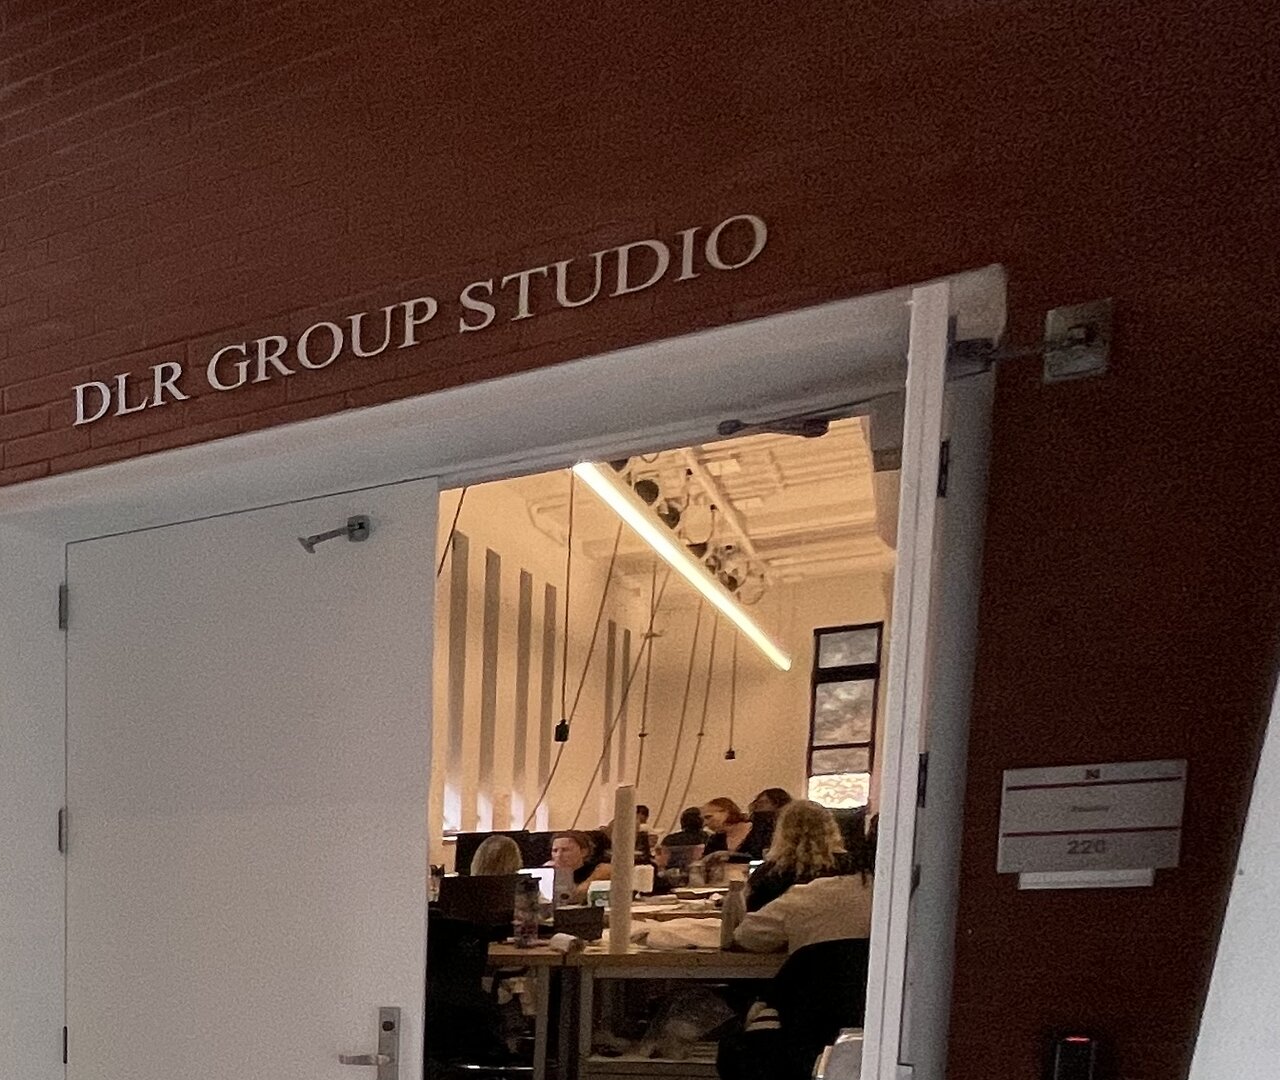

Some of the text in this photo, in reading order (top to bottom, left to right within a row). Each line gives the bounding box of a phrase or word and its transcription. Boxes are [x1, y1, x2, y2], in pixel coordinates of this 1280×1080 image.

[71, 213, 770, 426] DLR GROUP STUDIO
[1067, 839, 1107, 855] 220
